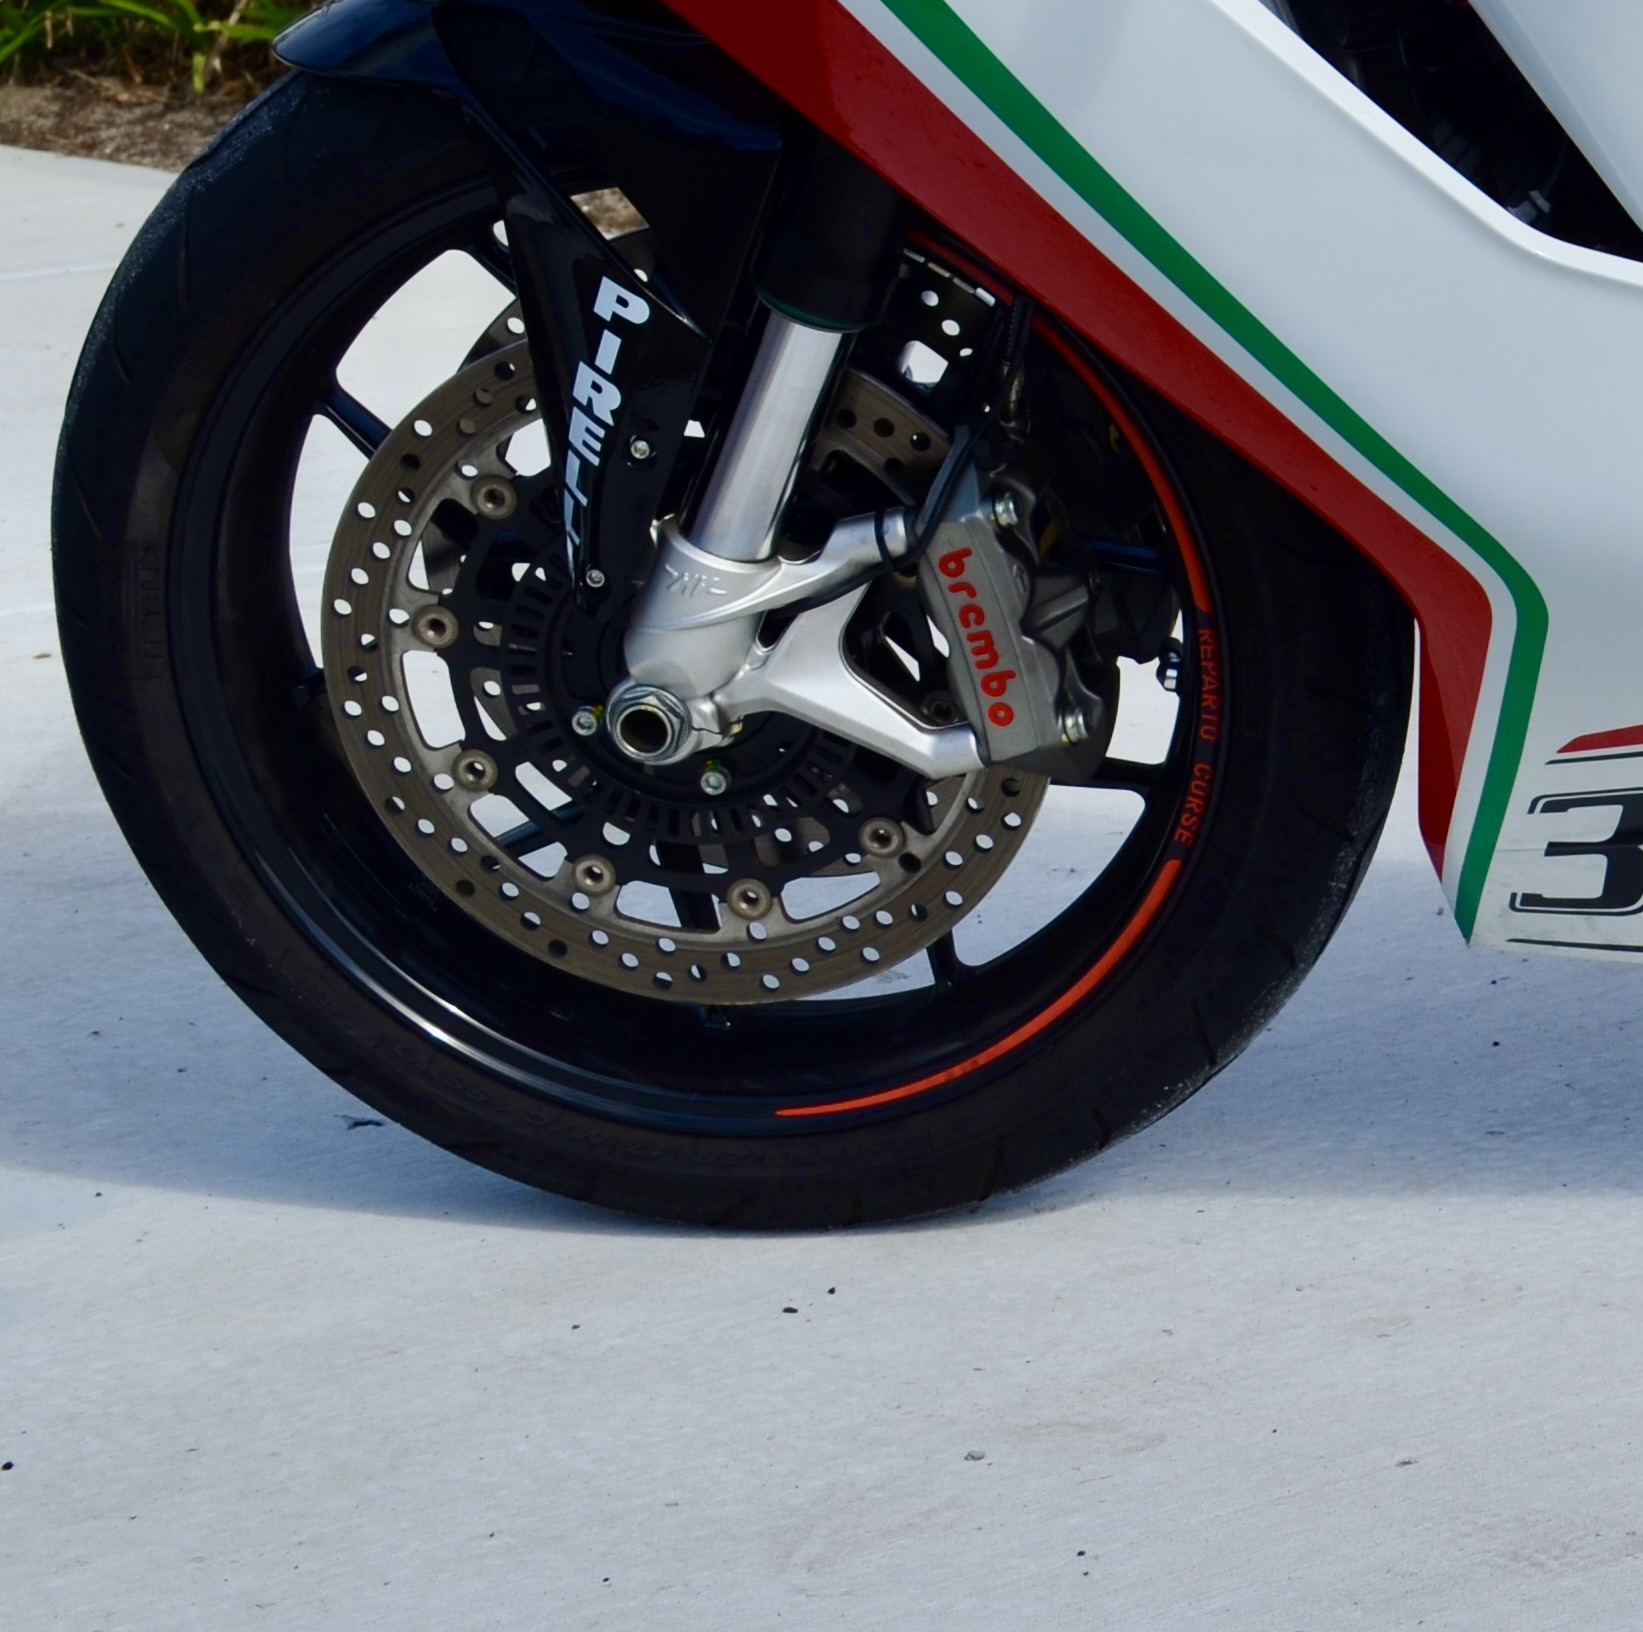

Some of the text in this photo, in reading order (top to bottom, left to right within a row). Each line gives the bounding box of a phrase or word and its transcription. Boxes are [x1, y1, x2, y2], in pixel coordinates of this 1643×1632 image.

[563, 275, 651, 590] PIRELLI
[937, 547, 1017, 728] brembo
[1173, 628, 1221, 847] REPARTO CORSE
